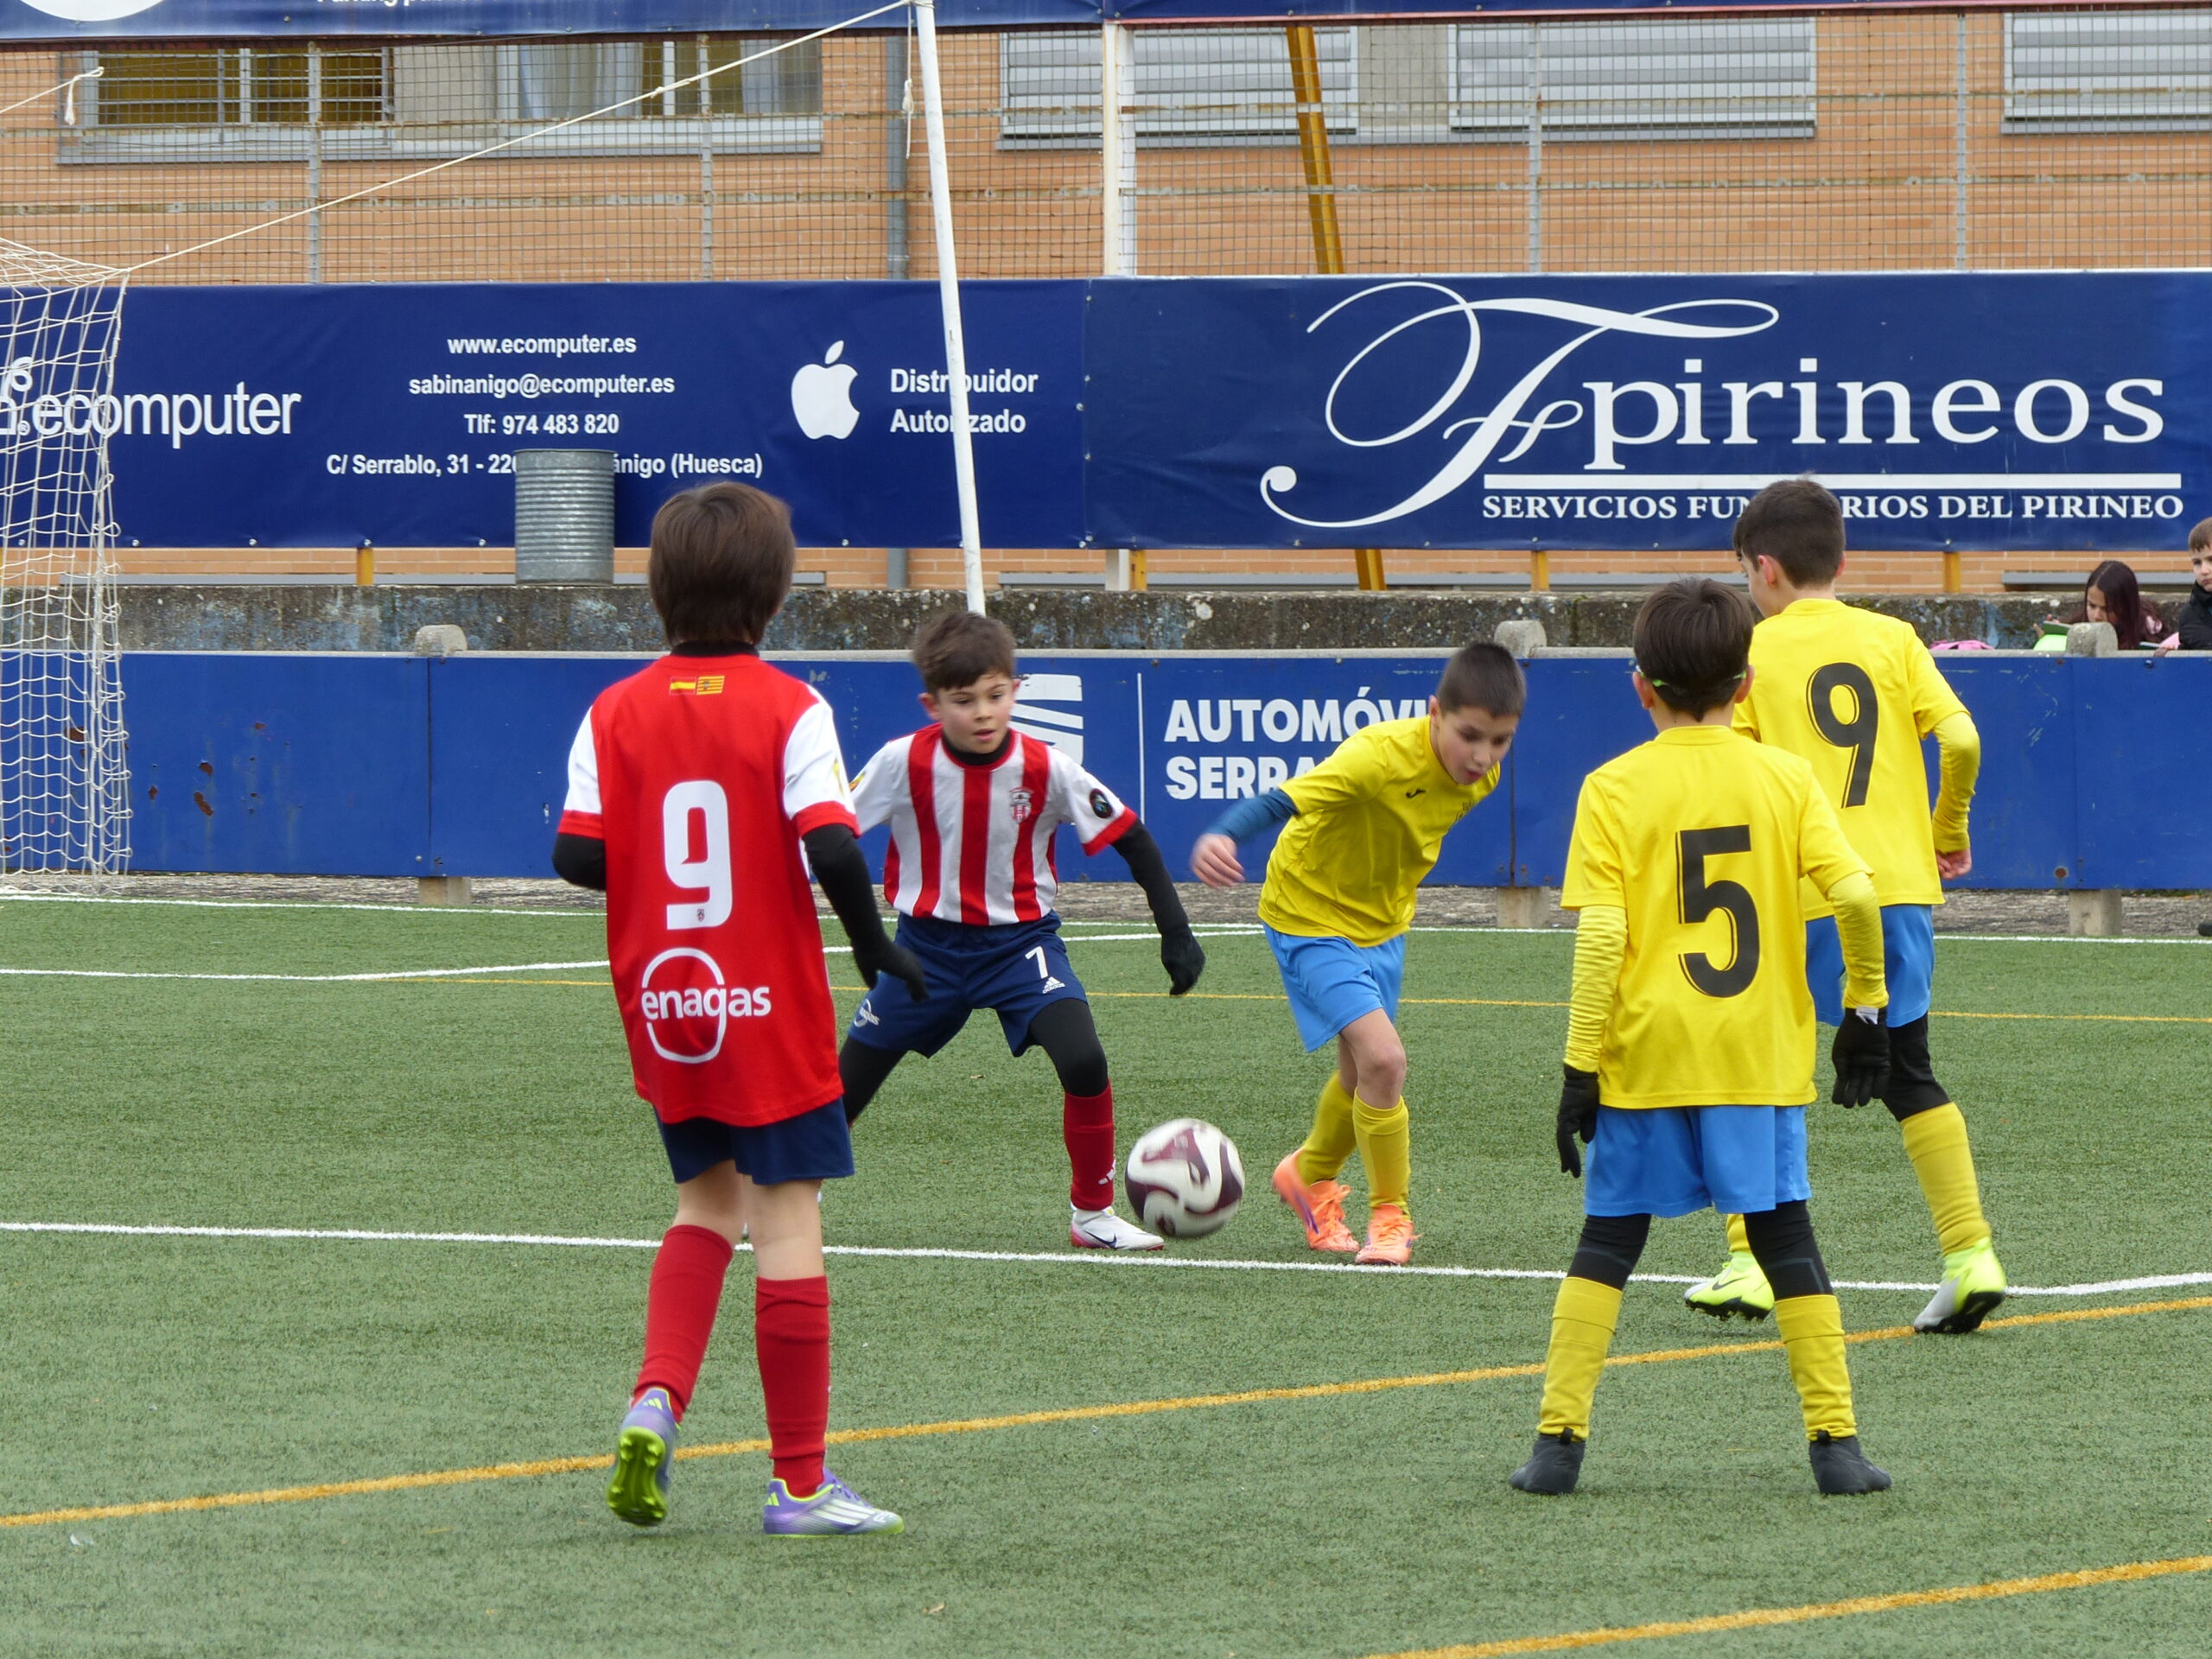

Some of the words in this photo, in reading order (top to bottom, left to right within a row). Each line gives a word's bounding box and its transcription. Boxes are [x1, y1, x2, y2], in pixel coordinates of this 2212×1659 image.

[447, 334, 637, 359] www.ecomputer.es
[409, 373, 675, 399] sabinanigo@ecomputer.es
[891, 368, 1039, 393] Distruidor
[33, 381, 302, 448] ecomputer
[464, 413, 496, 434] Tlf:
[502, 414, 539, 435] 974
[543, 414, 579, 435] 483
[584, 413, 620, 435] 820
[890, 409, 1027, 433] Autozado
[327, 454, 348, 474] C/
[352, 454, 442, 477] Serrablo,
[447, 454, 468, 474] 31
[671, 453, 763, 479] (Huesca)
[1483, 495, 1677, 519] SERVICIOS
[1938, 495, 2013, 518] DEL
[2022, 495, 2183, 518] PIRINEO
[1806, 662, 1879, 809] 9
[663, 780, 734, 931] 9
[1675, 824, 1761, 999] 5
[1025, 946, 1049, 979] 7
